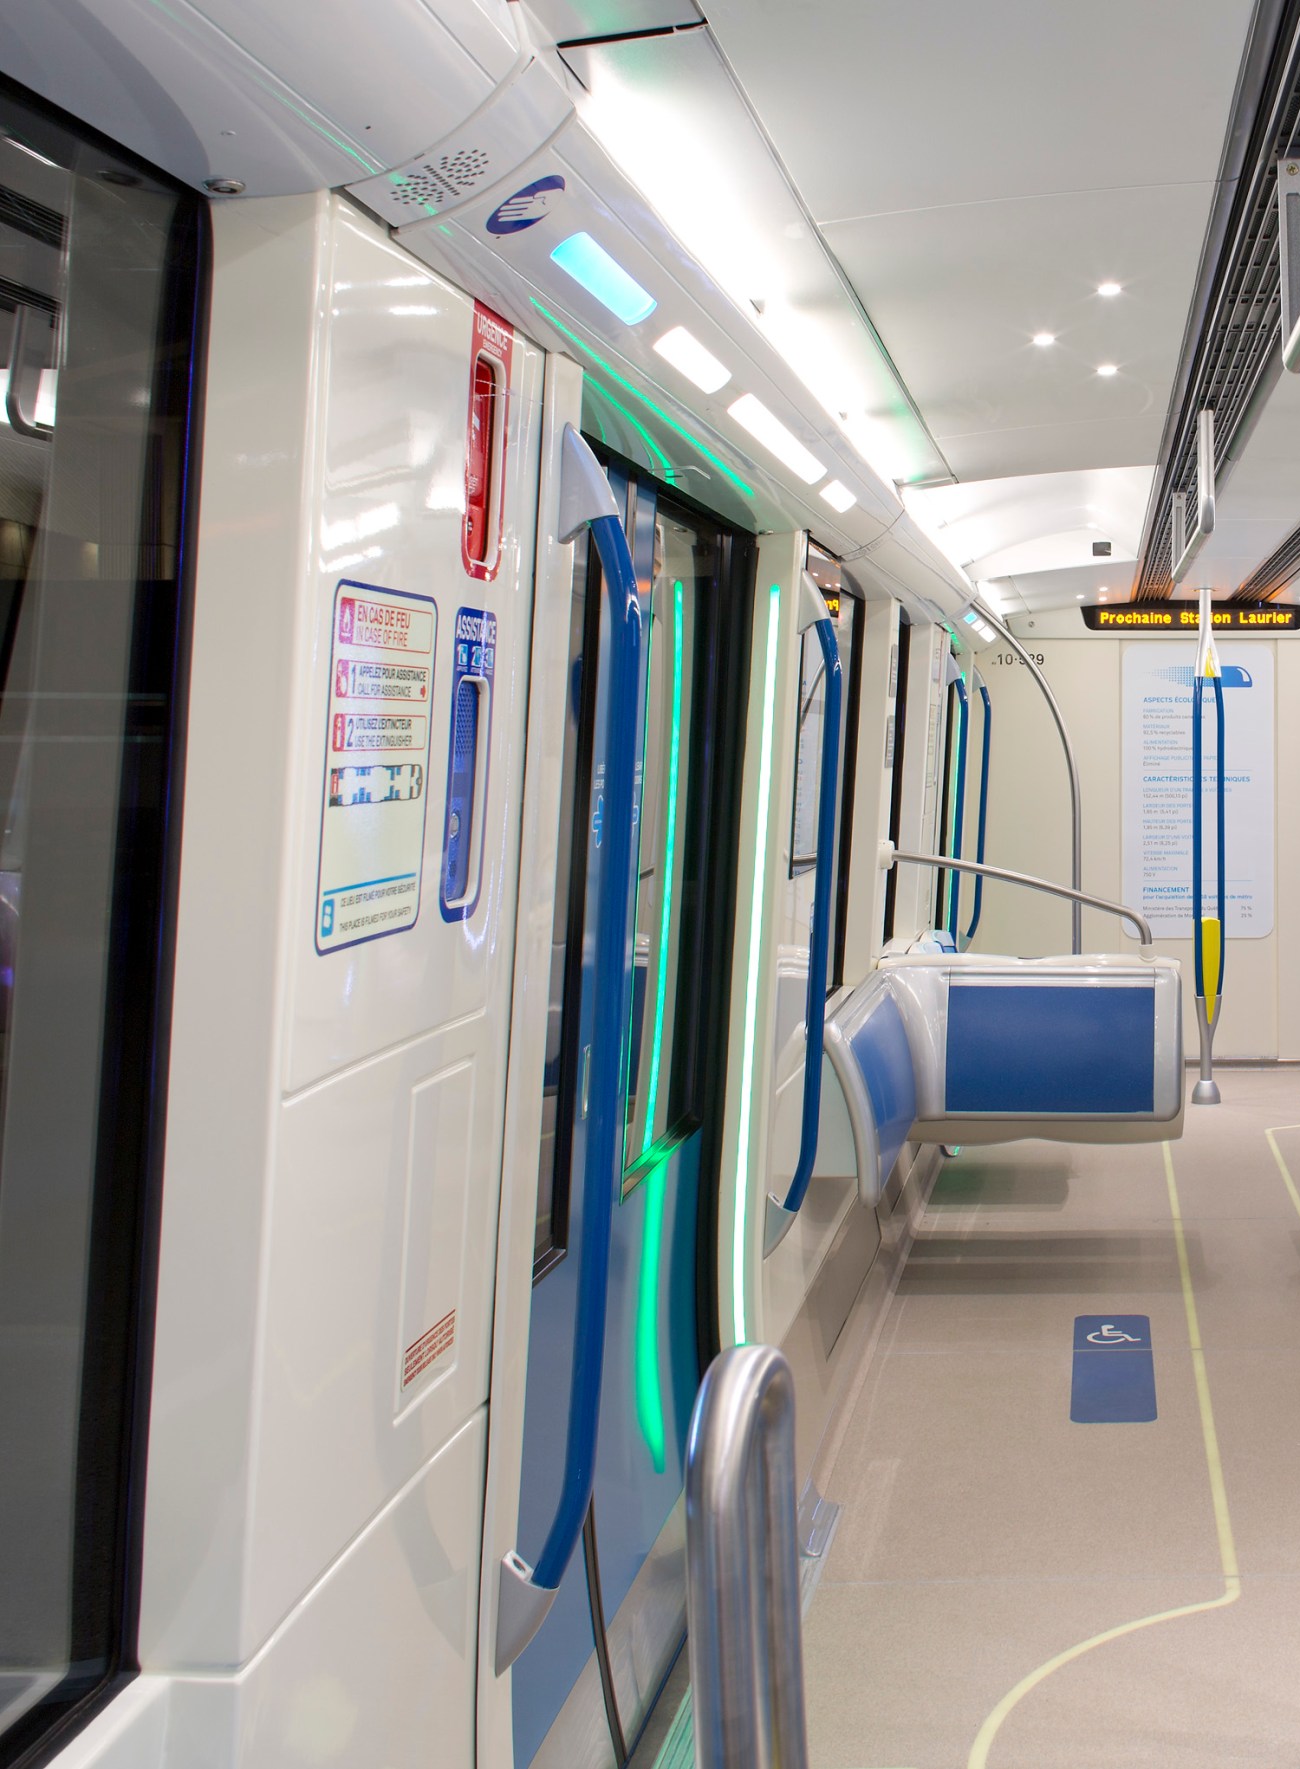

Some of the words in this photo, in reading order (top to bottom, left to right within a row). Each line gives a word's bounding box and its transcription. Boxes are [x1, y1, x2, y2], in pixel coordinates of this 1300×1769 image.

[477, 312, 508, 351] URGENCE
[357, 604, 368, 622] EN
[370, 606, 384, 625] CAS
[385, 610, 394, 627] DE
[396, 612, 411, 629] FEU
[1100, 612, 1172, 624] Prochaine
[1180, 612, 1231, 624] Staion
[1240, 612, 1291, 624] Laurier
[356, 626, 364, 641] IN
[365, 626, 382, 644] CASE
[384, 629, 392, 645] OF
[394, 630, 408, 647] FIRE
[351, 664, 356, 694] 1
[359, 666, 382, 678] APPELEZ
[382, 668, 396, 680] POUR
[396, 669, 426, 682] ASSISTANCE
[358, 683, 370, 695] CALL
[370, 684, 380, 696] FOR
[382, 684, 412, 698] ASSISTANCE
[346, 718, 354, 748] 2
[356, 718, 378, 730] UTILISEZ
[378, 718, 412, 730] L'EXTINCTEUR
[355, 736, 364, 748] USE
[366, 736, 376, 748] THE
[376, 735, 412, 747] EXTINGUISHER
